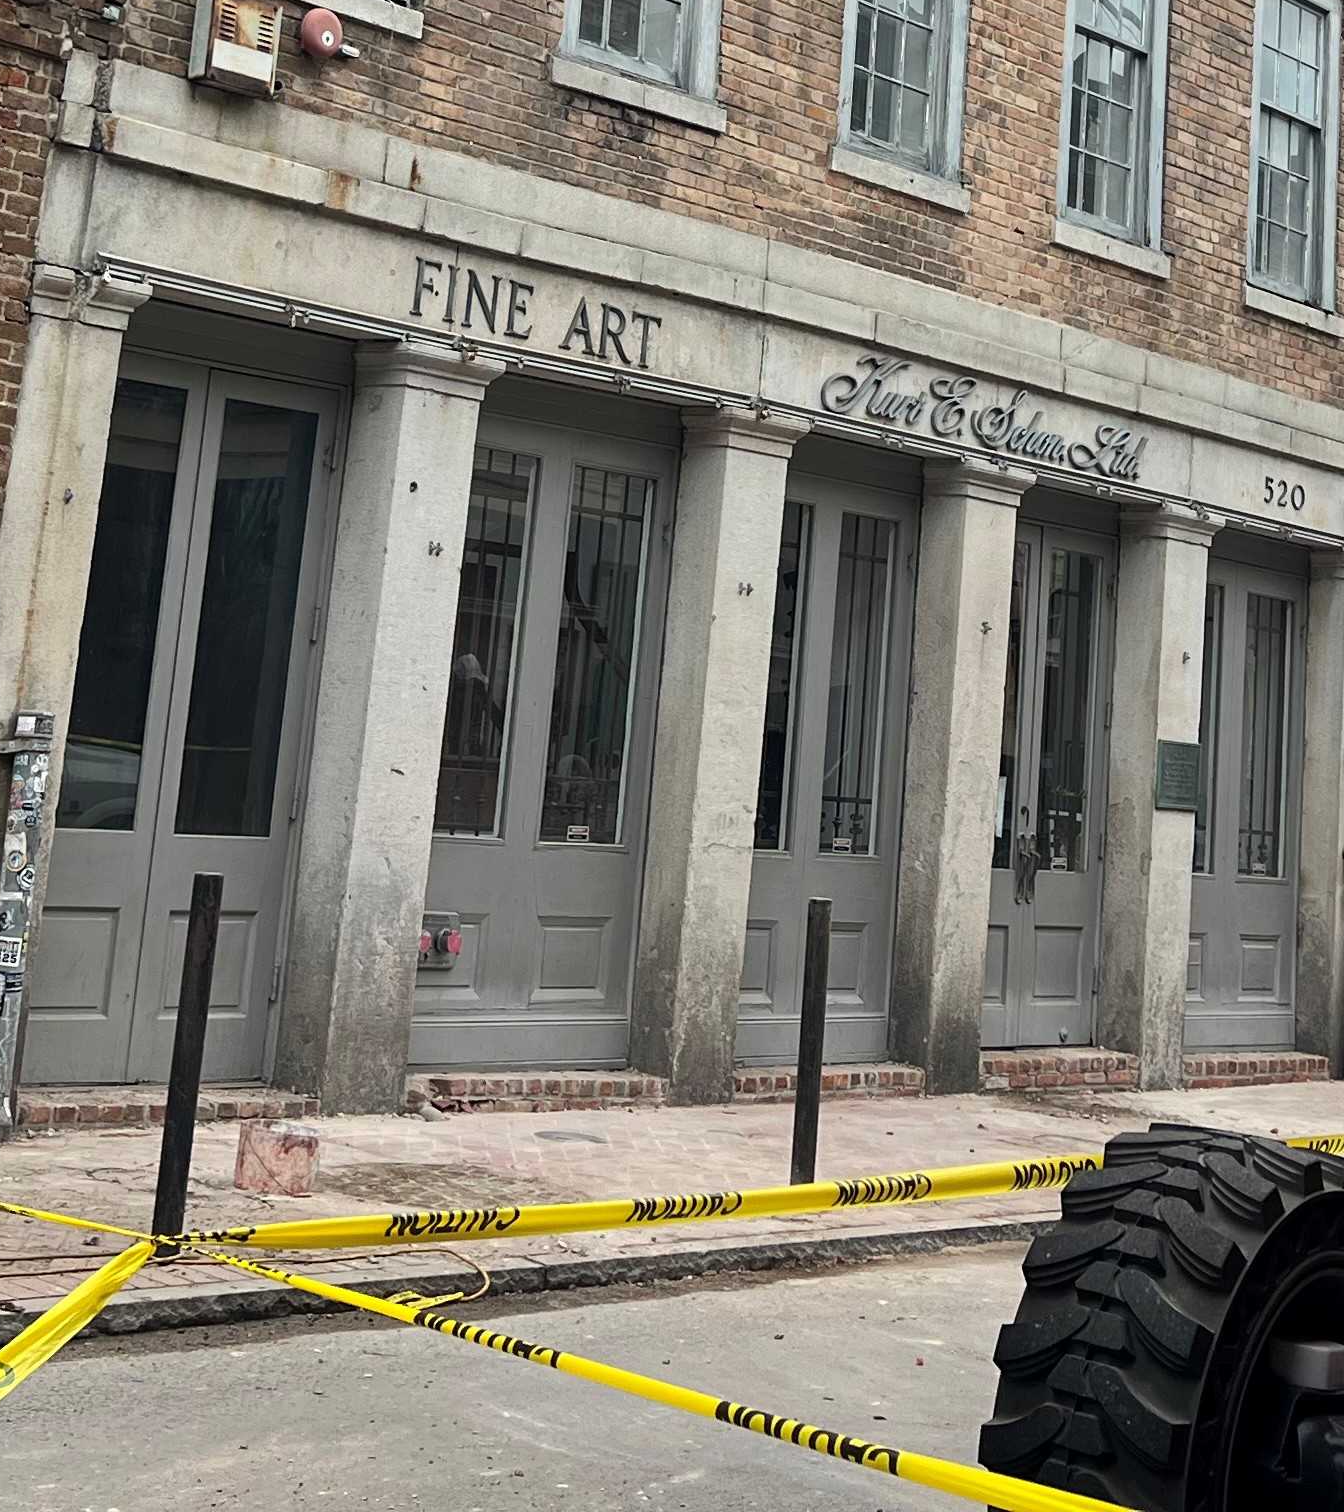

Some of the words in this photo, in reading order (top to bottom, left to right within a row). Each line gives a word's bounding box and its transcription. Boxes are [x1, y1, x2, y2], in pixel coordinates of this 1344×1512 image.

[409, 256, 534, 339] FINE
[558, 296, 662, 368] ART
[820, 355, 926, 425] Kurt
[1264, 476, 1305, 511] 520
[831, 1173, 933, 1206] CAUTION
